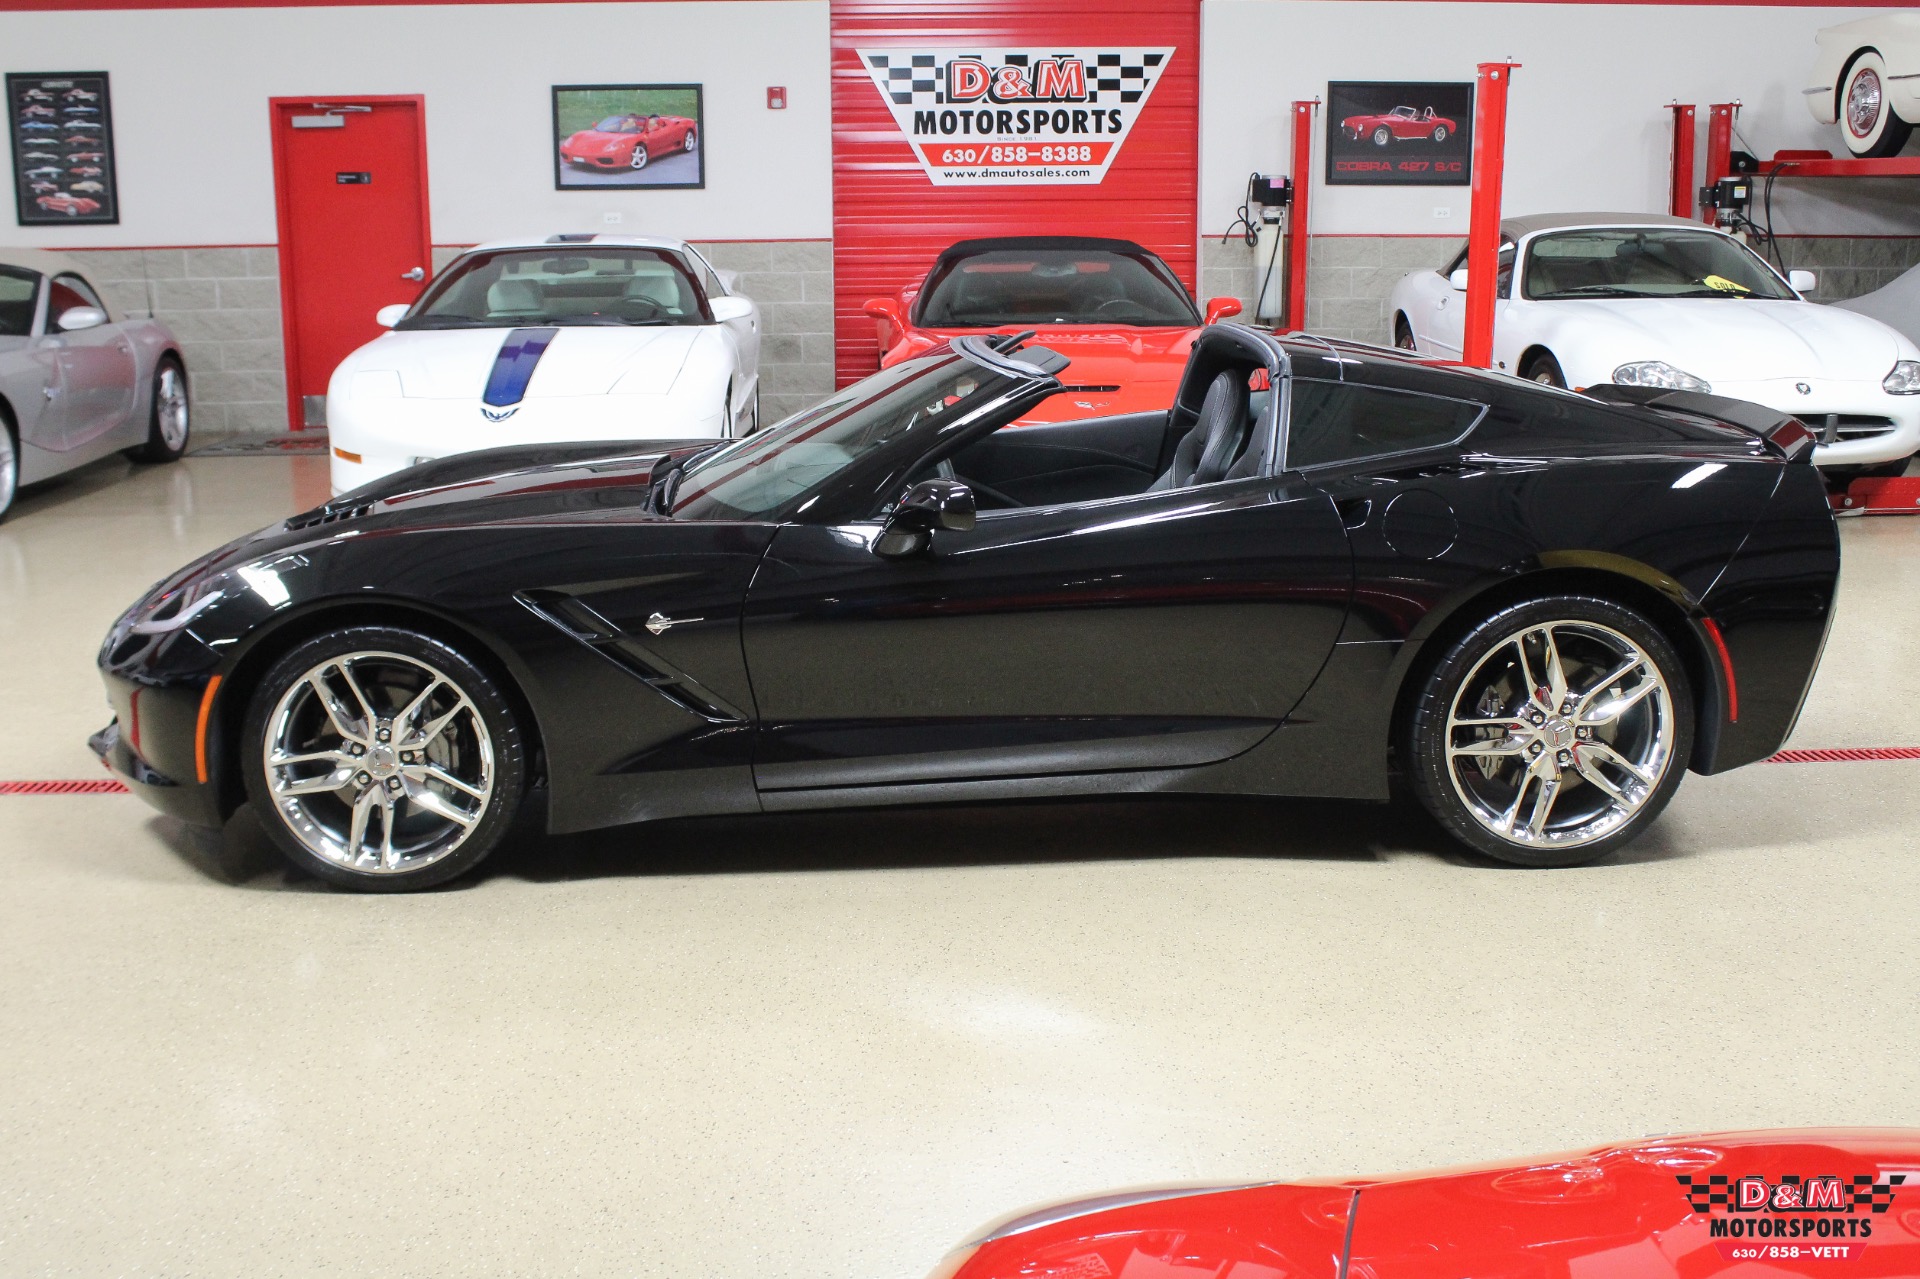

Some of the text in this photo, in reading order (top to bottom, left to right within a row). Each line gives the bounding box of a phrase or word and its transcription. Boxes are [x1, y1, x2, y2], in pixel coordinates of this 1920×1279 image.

[946, 57, 1089, 103] D&M
[913, 108, 1123, 135] MOTORSPORTS
[942, 145, 1092, 164] 630/858-8388
[943, 166, 1091, 179] www.dmautosales.com
[1335, 161, 1462, 172] COBRA 427 S/C
